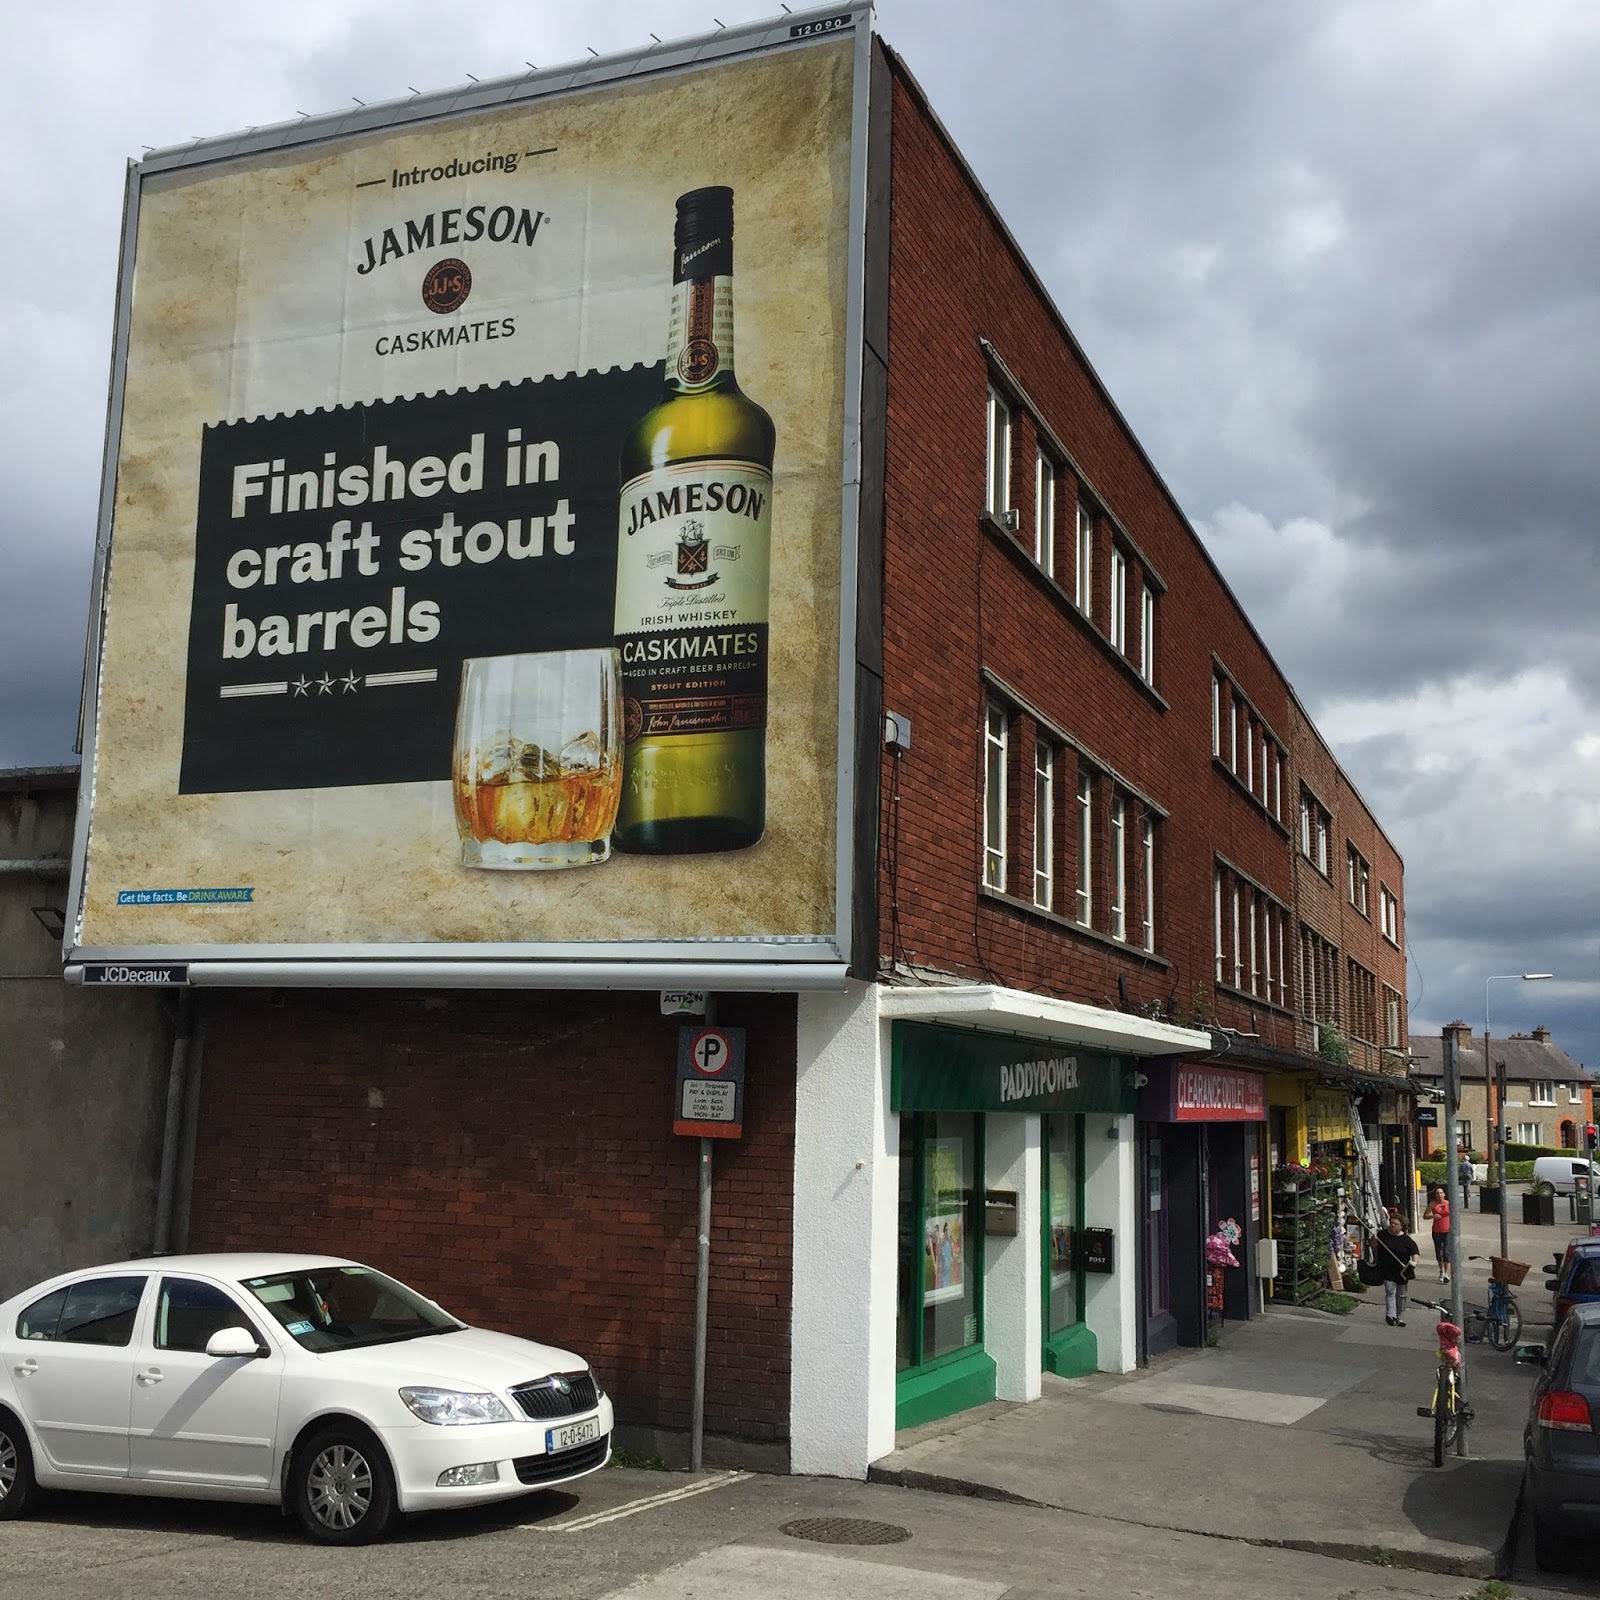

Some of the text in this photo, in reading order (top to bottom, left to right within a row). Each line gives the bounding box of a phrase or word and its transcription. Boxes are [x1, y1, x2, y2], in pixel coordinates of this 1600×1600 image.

[797, 18, 842, 36] 12090
[391, 152, 518, 188] Introducing
[357, 205, 546, 275] JAMESON
[375, 317, 516, 356] CASKMATES
[231, 428, 560, 519] Finished in
[627, 482, 764, 536] JAMESON
[226, 499, 576, 589] craft stout
[222, 586, 441, 659] barrels
[641, 610, 737, 626] IRISH WHISKEY
[623, 632, 758, 663] CASKMATES
[628, 670, 647, 678] AGED
[659, 666, 687, 675] CRAFT
[690, 665, 713, 673] BEER
[716, 662, 751, 672] BARRELS
[651, 680, 727, 691] STOUT EDITION
[120, 890, 248, 904] Get the facts. Be DRINKAWARE
[100, 966, 171, 982] JCDecaux
[703, 1038, 720, 1067] P
[1000, 1056, 1078, 1102] PADDYPOWER
[1177, 1072, 1221, 1109] CLEARANCE
[1222, 1076, 1244, 1110] OUTLET
[560, 1423, 594, 1446] 12-D-5473
